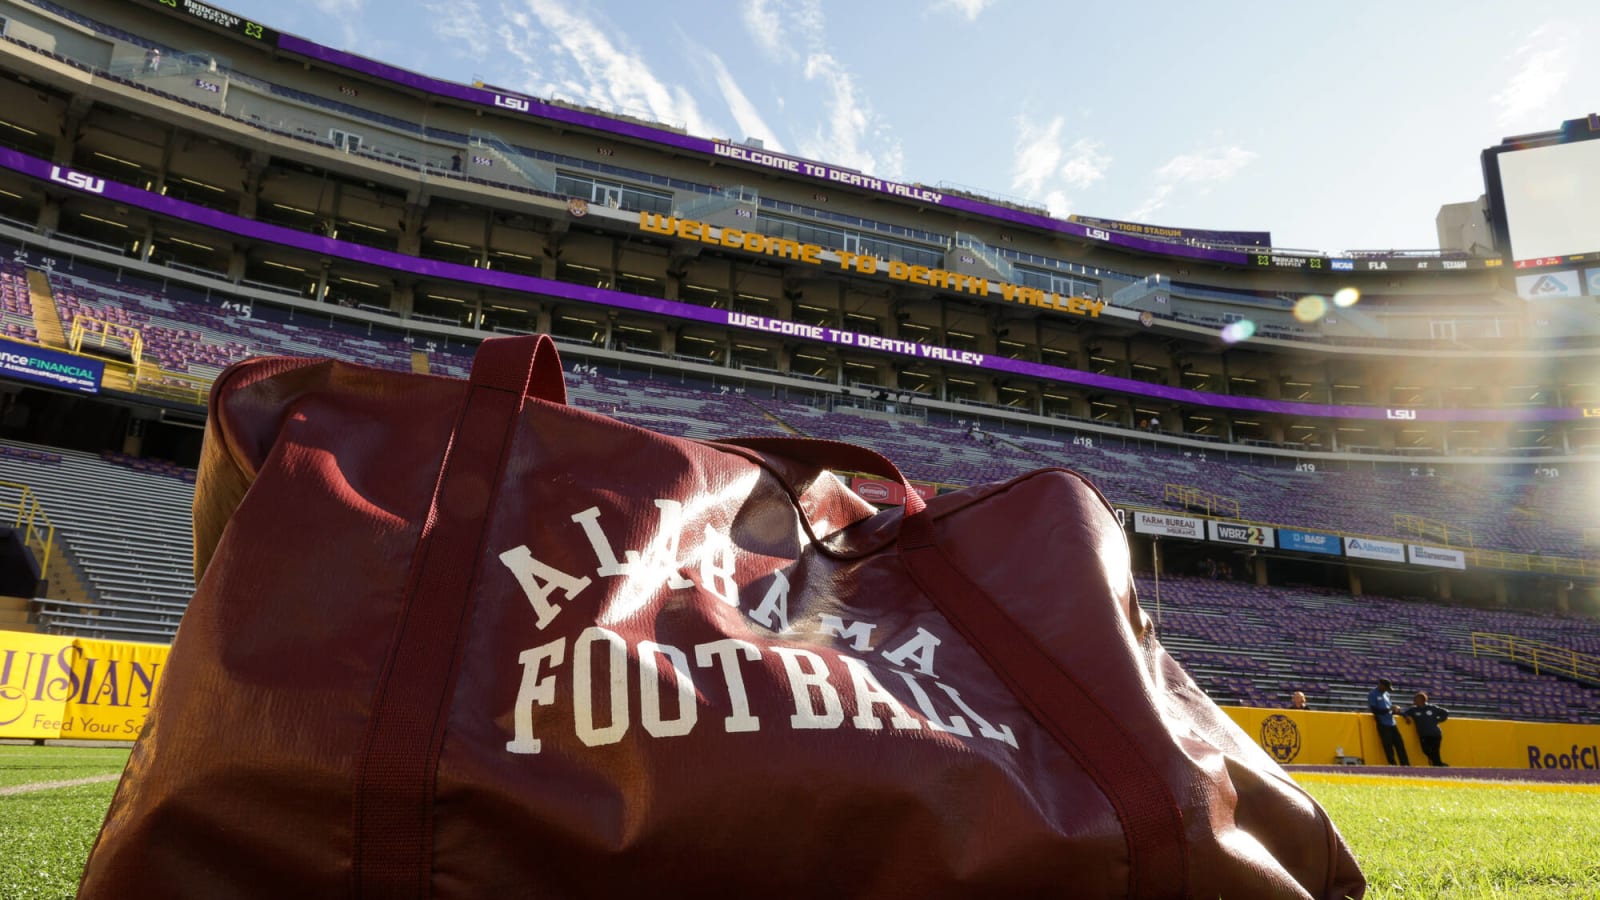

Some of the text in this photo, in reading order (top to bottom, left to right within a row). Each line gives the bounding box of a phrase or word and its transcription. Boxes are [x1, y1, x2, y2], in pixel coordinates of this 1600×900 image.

[184, 0, 239, 25] BRIDGEWAY
[189, 8, 230, 27] HOSPICE
[494, 95, 529, 112] LSU
[50, 166, 104, 193] LSU
[715, 144, 942, 203] WELCOME TO DEATH VALLEY
[1086, 228, 1110, 241] LSU
[1119, 223, 1142, 233] TIGER
[1143, 227, 1182, 237] STADIUM
[639, 211, 1104, 318] WELCOME TO DEATH VALLEY
[1368, 261, 1388, 270] FLA
[221, 300, 252, 318] 415
[728, 311, 984, 366] WELCOME TO DEATH VALLEY
[28, 358, 95, 380] FINANCIAL
[573, 363, 598, 378] 416
[1386, 409, 1416, 420] LSU
[1072, 436, 1094, 448] 418
[1295, 463, 1316, 474] 419
[1142, 515, 1195, 529] FARM BUREAU
[1219, 527, 1248, 540] WBRZ
[1304, 534, 1326, 544] BASF
[499, 498, 942, 678] ALABAMA
[506, 626, 1019, 754] FOOTBALL
[33, 714, 73, 732] Feed
[80, 717, 119, 733] Your
[1527, 744, 1599, 769] RoofCl
